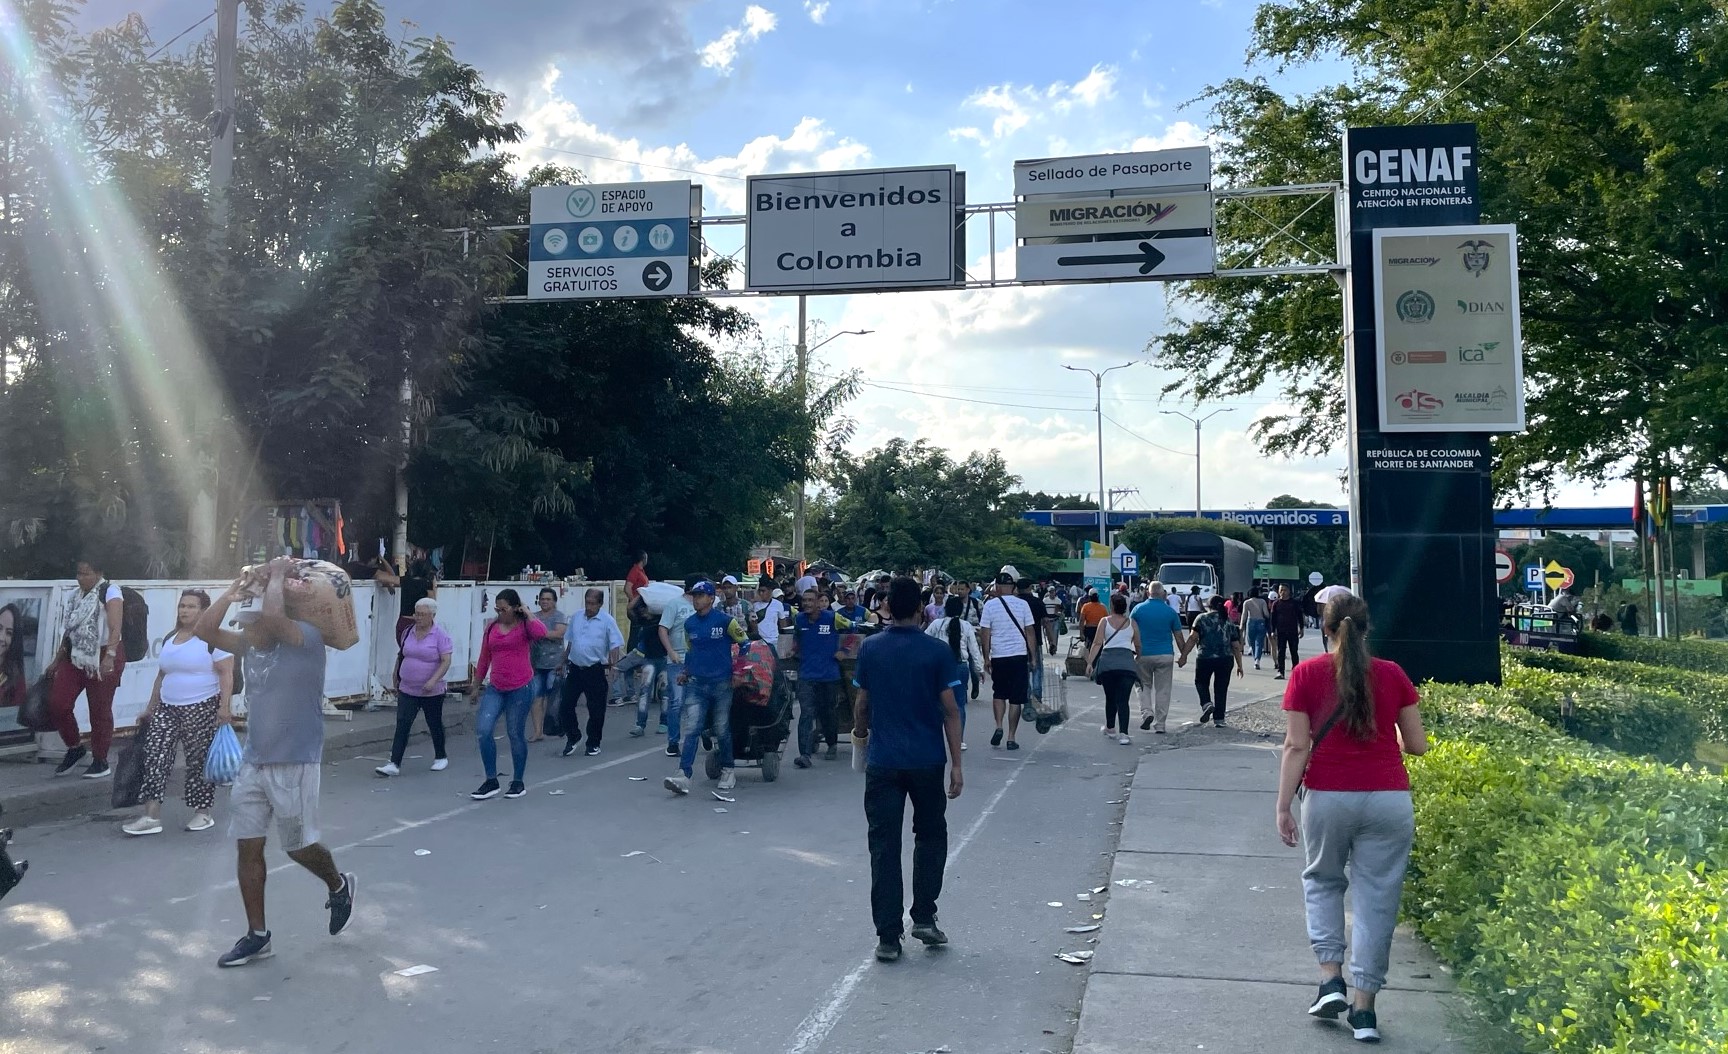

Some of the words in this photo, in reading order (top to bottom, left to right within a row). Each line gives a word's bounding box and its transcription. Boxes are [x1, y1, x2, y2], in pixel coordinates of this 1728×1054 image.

[1028, 166, 1084, 182] Sellado
[1089, 165, 1107, 177] de
[1113, 160, 1192, 176] Pasaporte
[1355, 146, 1472, 185] CENAF
[602, 189, 646, 201] ESPACIO
[1362, 188, 1399, 198] CENTRO
[1401, 187, 1452, 196] NACIONAL
[1454, 186, 1466, 194] DE
[755, 185, 942, 212] Bienvenidos
[1356, 197, 1404, 209] ATENCIÓN
[1406, 198, 1418, 207] EN
[1421, 196, 1473, 206] FRONTERAS
[601, 203, 615, 213] DE
[617, 201, 653, 213] APOYO
[1049, 201, 1162, 221] MIGRACIÓN
[840, 219, 856, 237] a
[776, 248, 922, 272] Colombia
[547, 265, 615, 278] SERVICIOS
[543, 280, 618, 292] GRATUITOS
[1469, 301, 1504, 313] DIAN
[1459, 346, 1484, 362] ica
[1366, 448, 1414, 458] REPÚBLICA
[1430, 449, 1482, 457] COLOMBIA
[1375, 460, 1404, 468] NORTE
[1420, 460, 1474, 468] SANTANDER
[1221, 510, 1317, 525] Bienvenidos
[1332, 513, 1343, 525] a
[1126, 556, 1133, 567] P
[1531, 569, 1539, 581] P
[711, 627, 724, 636] 219
